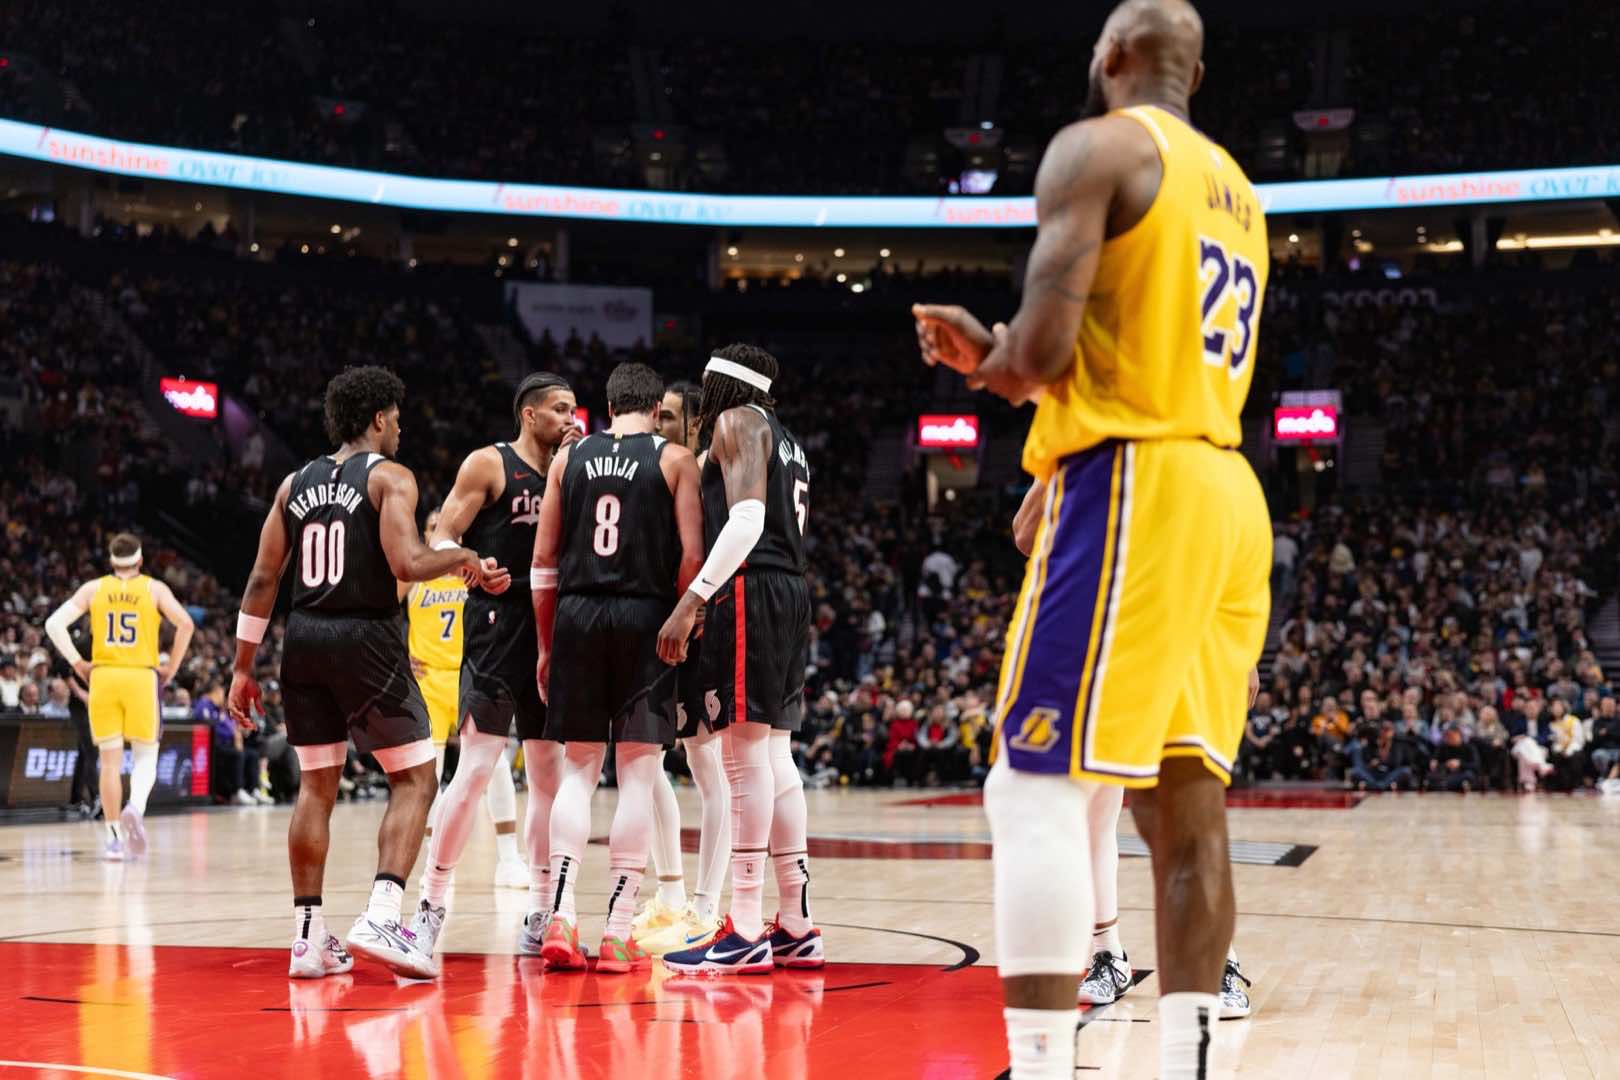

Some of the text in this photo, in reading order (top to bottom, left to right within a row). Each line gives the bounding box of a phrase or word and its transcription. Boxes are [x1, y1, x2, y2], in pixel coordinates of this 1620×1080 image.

[50, 139, 168, 176] sunshine
[504, 193, 618, 217] sunshine
[1397, 178, 1520, 204] sunshine
[1198, 236, 1258, 381] 23
[584, 456, 640, 482] AVDIJA
[592, 494, 622, 557] 8
[793, 478, 809, 537] 5
[301, 519, 346, 588] 00
[105, 611, 138, 647] 15
[439, 609, 457, 642] 7
